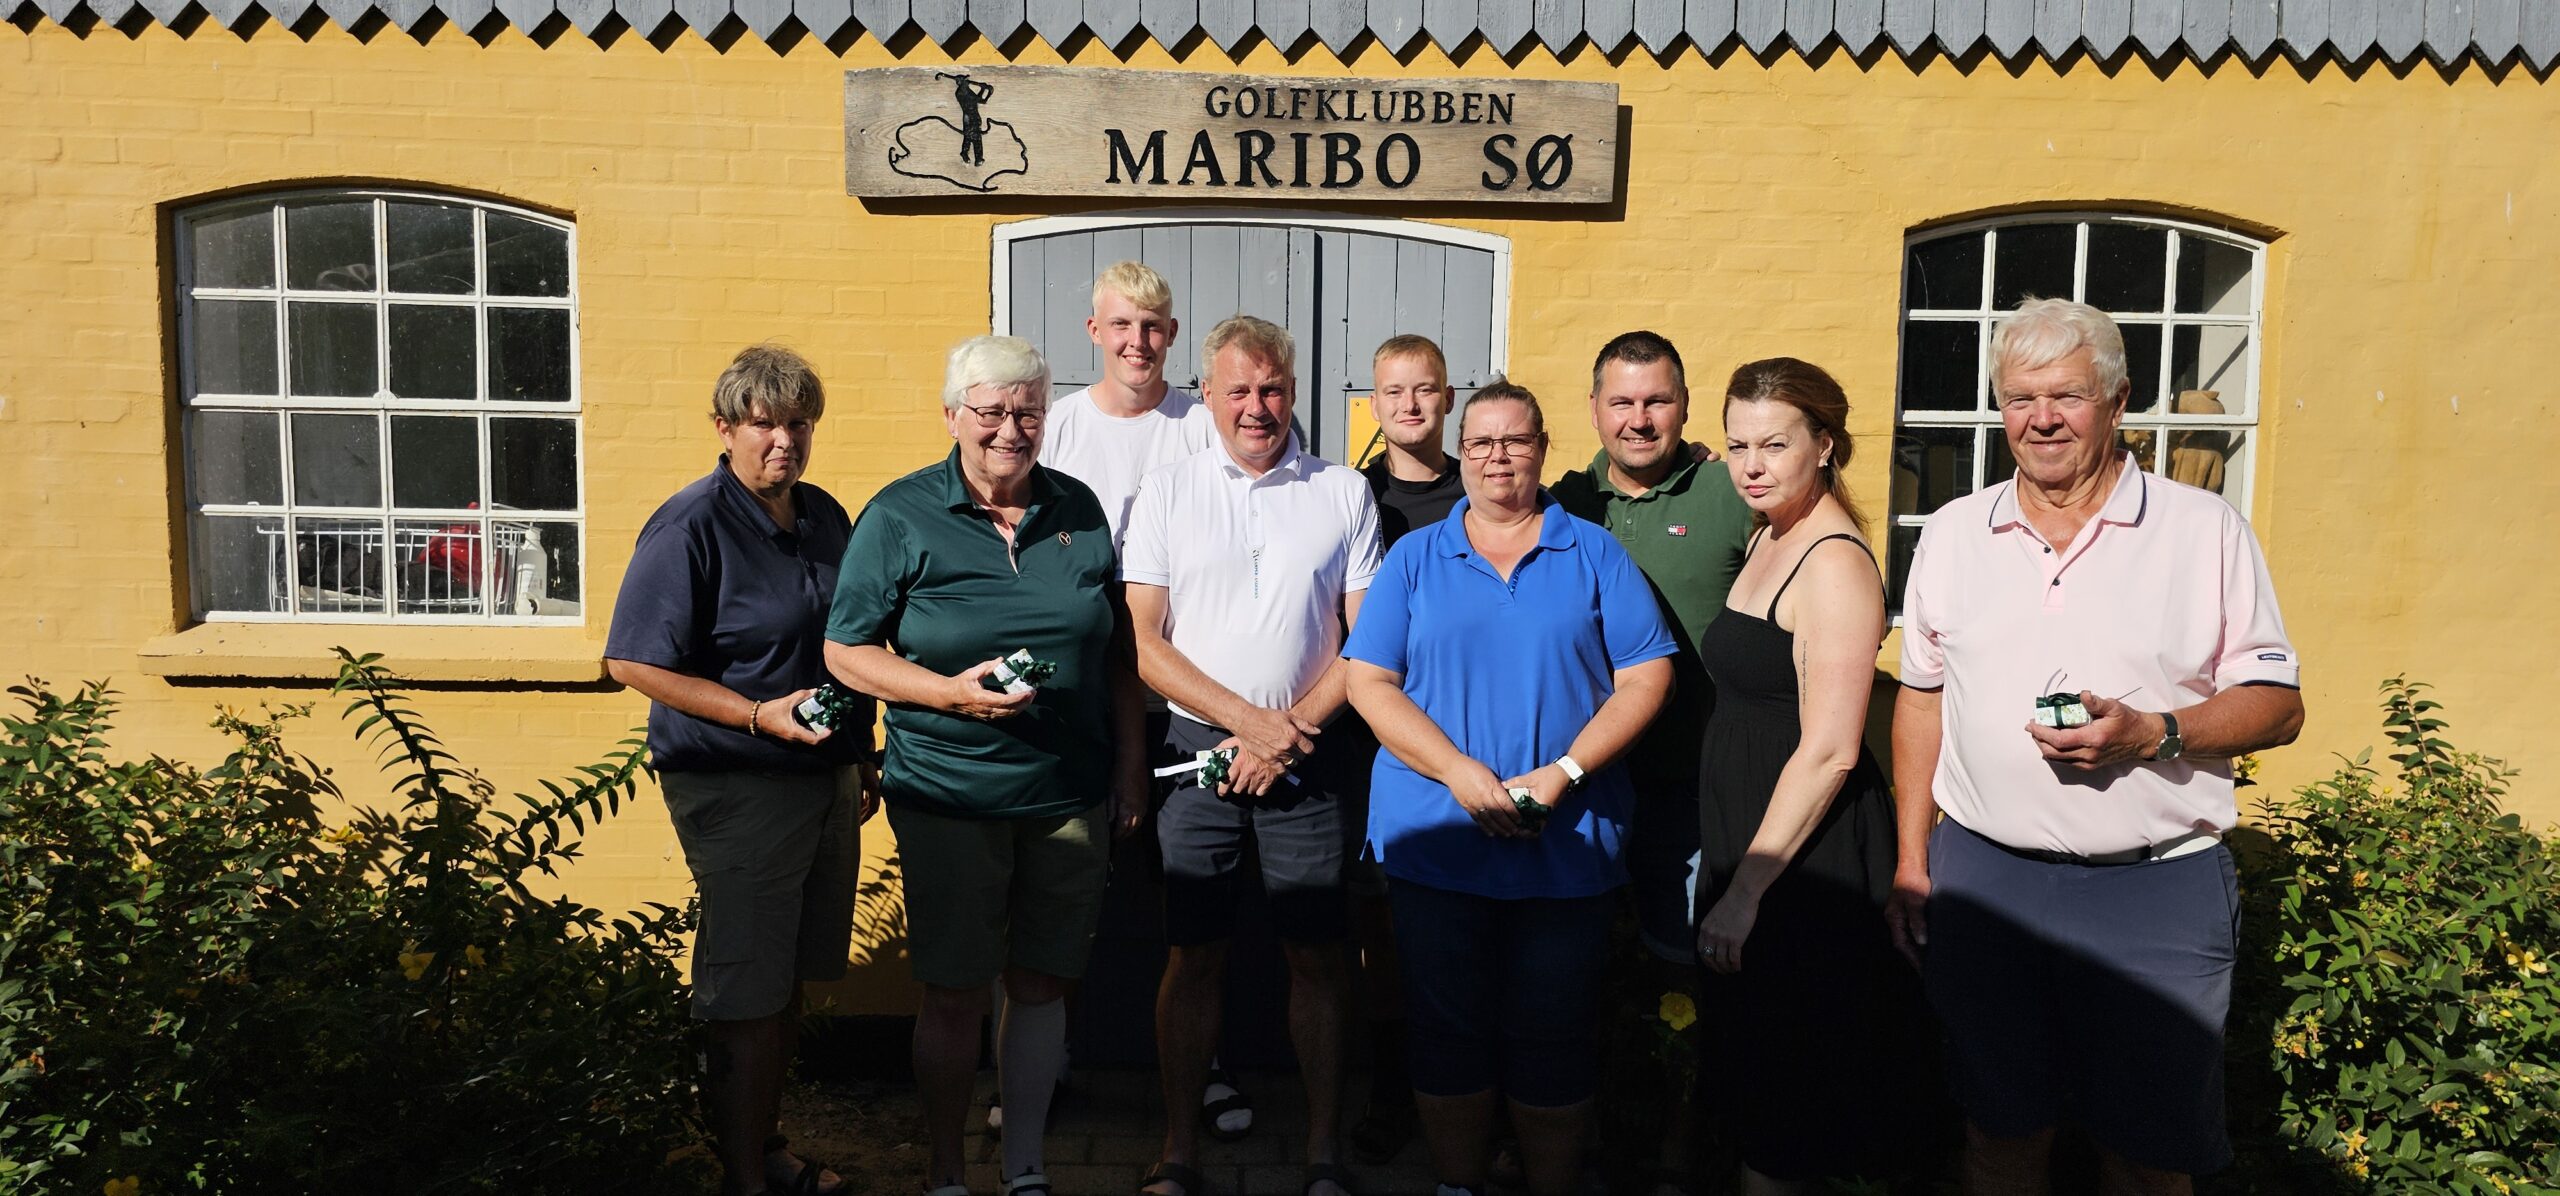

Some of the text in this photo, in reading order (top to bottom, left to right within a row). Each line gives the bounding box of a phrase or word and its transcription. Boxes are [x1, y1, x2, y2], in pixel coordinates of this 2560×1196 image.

[1205, 85, 1516, 126] GOLFKLUBBEN
[1104, 128, 1574, 192] MARIBO SØ
